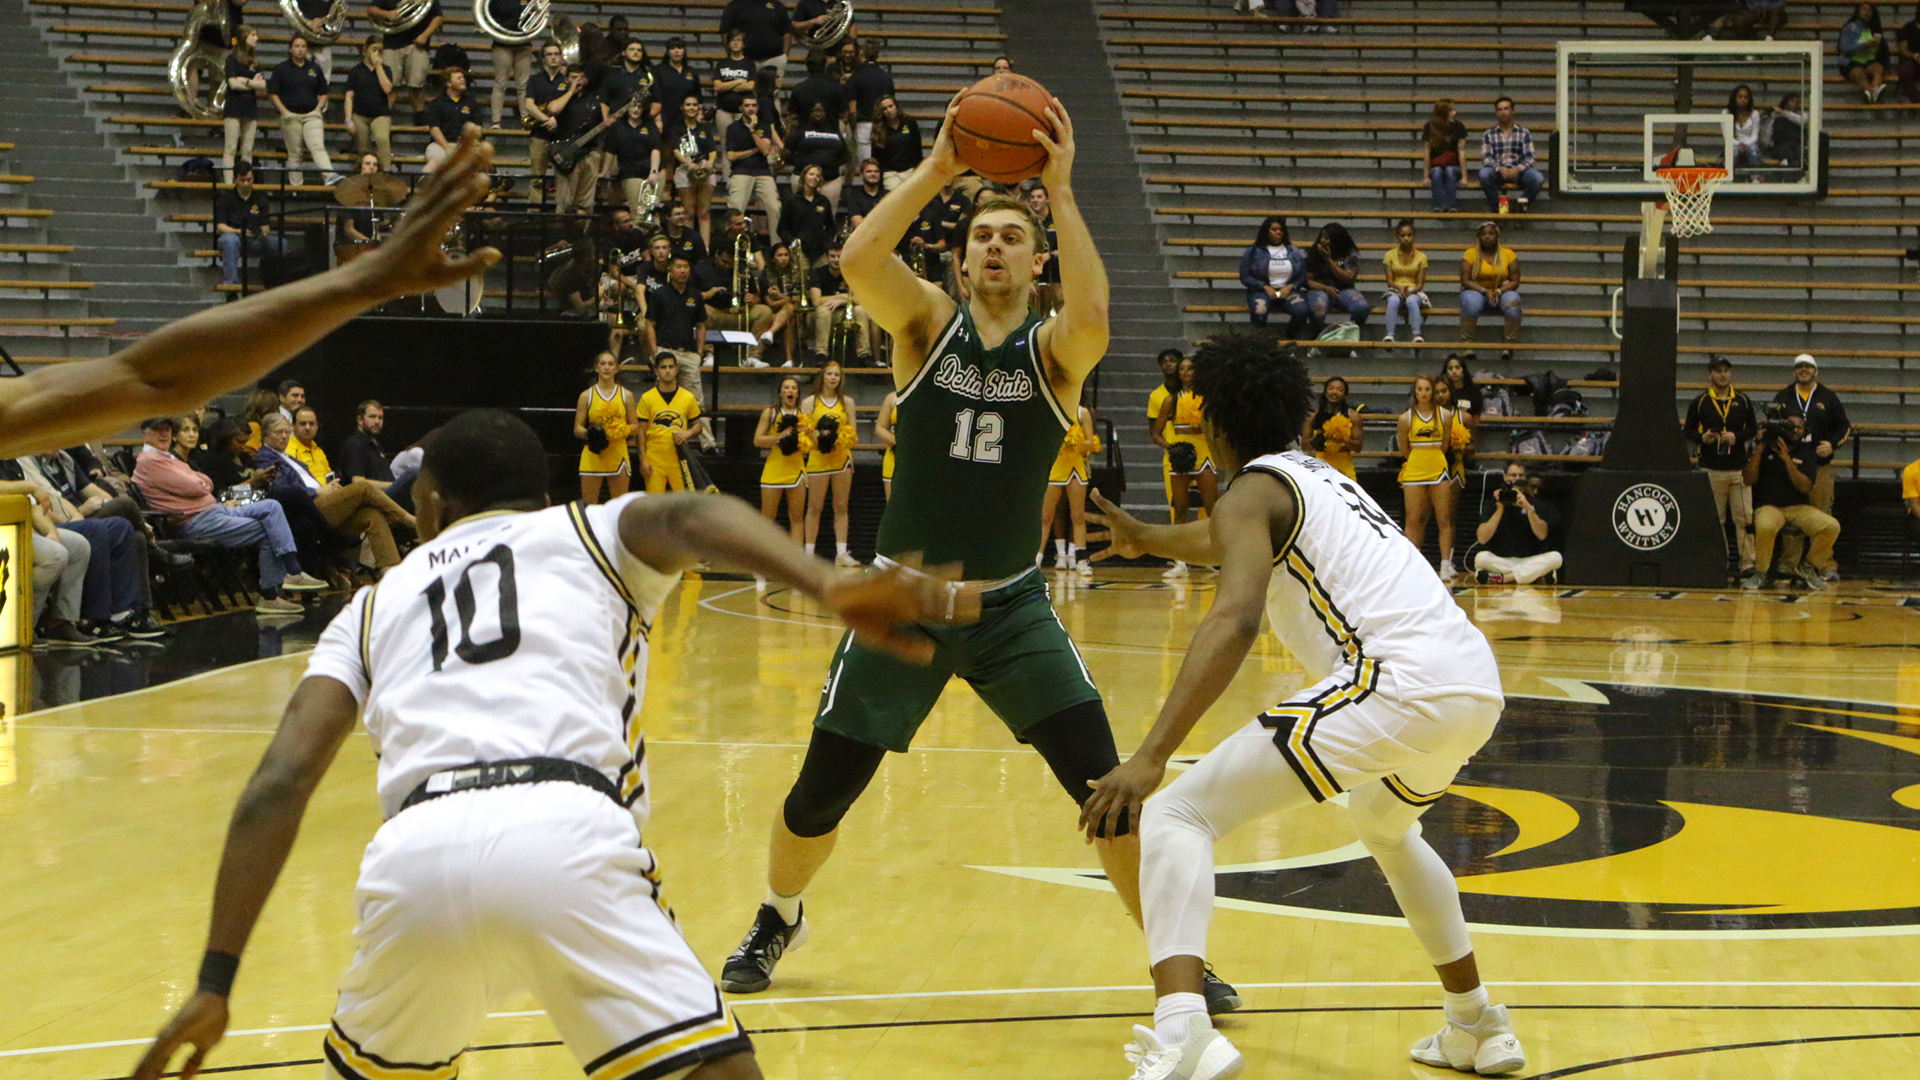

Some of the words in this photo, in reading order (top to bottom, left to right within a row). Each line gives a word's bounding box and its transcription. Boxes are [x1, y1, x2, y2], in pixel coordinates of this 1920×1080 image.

[934, 354, 982, 400] Delta
[983, 368, 1032, 402] State
[949, 407, 1004, 464] 12
[1617, 487, 1675, 513] HANCOCK
[1617, 520, 1674, 547] WHITNEY
[419, 543, 521, 673] 10
